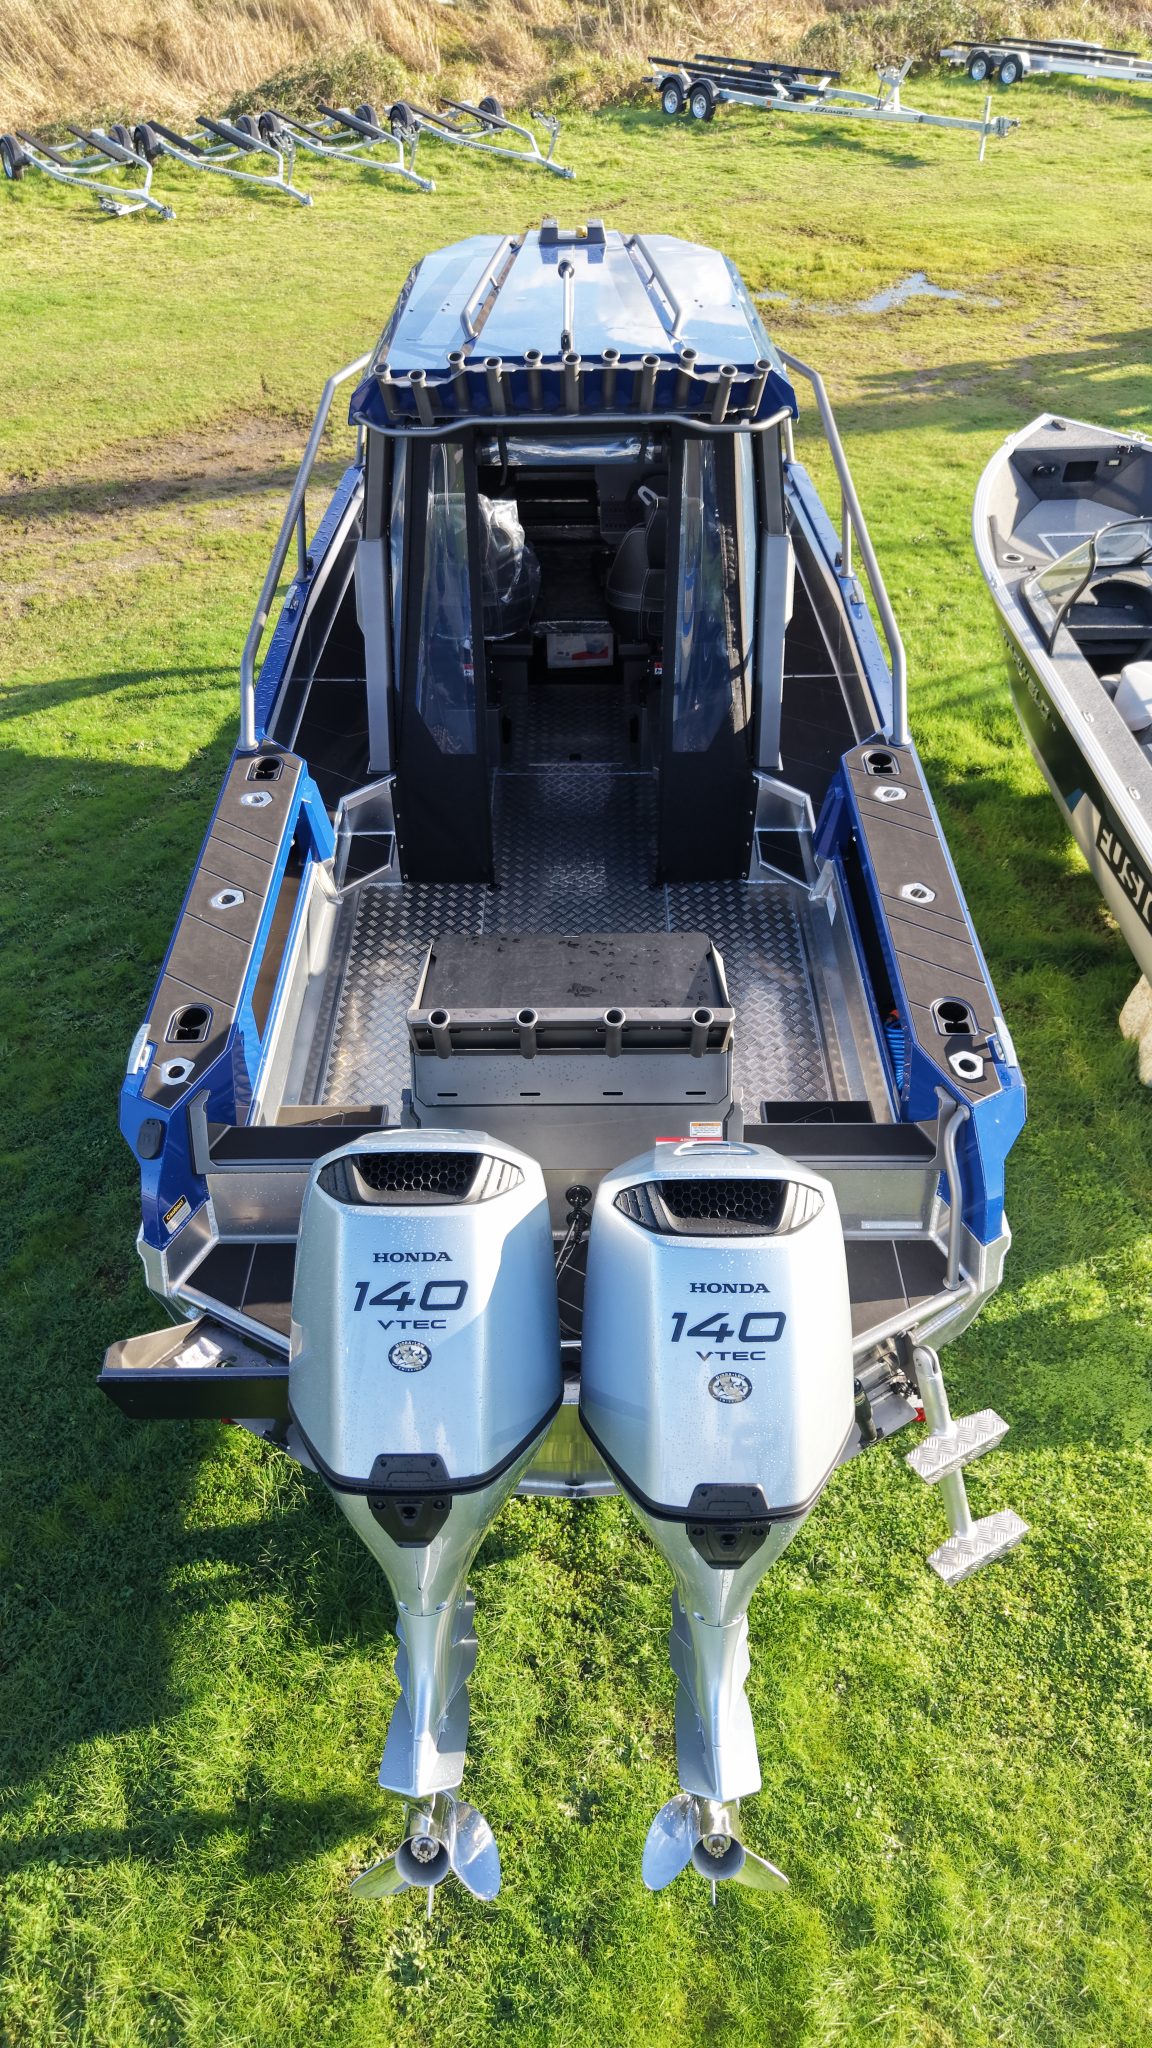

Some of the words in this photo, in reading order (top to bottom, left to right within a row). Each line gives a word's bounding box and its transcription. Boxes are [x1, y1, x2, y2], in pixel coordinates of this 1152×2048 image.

[1098, 824, 1152, 932] FUSI
[166, 1199, 184, 1220] Caution!
[373, 1251, 453, 1263] HONDA
[354, 1280, 469, 1311] 140
[689, 1282, 771, 1294] HONDA
[377, 1319, 447, 1331] VTEC
[671, 1311, 787, 1343] 140
[696, 1350, 766, 1362] VTEC
